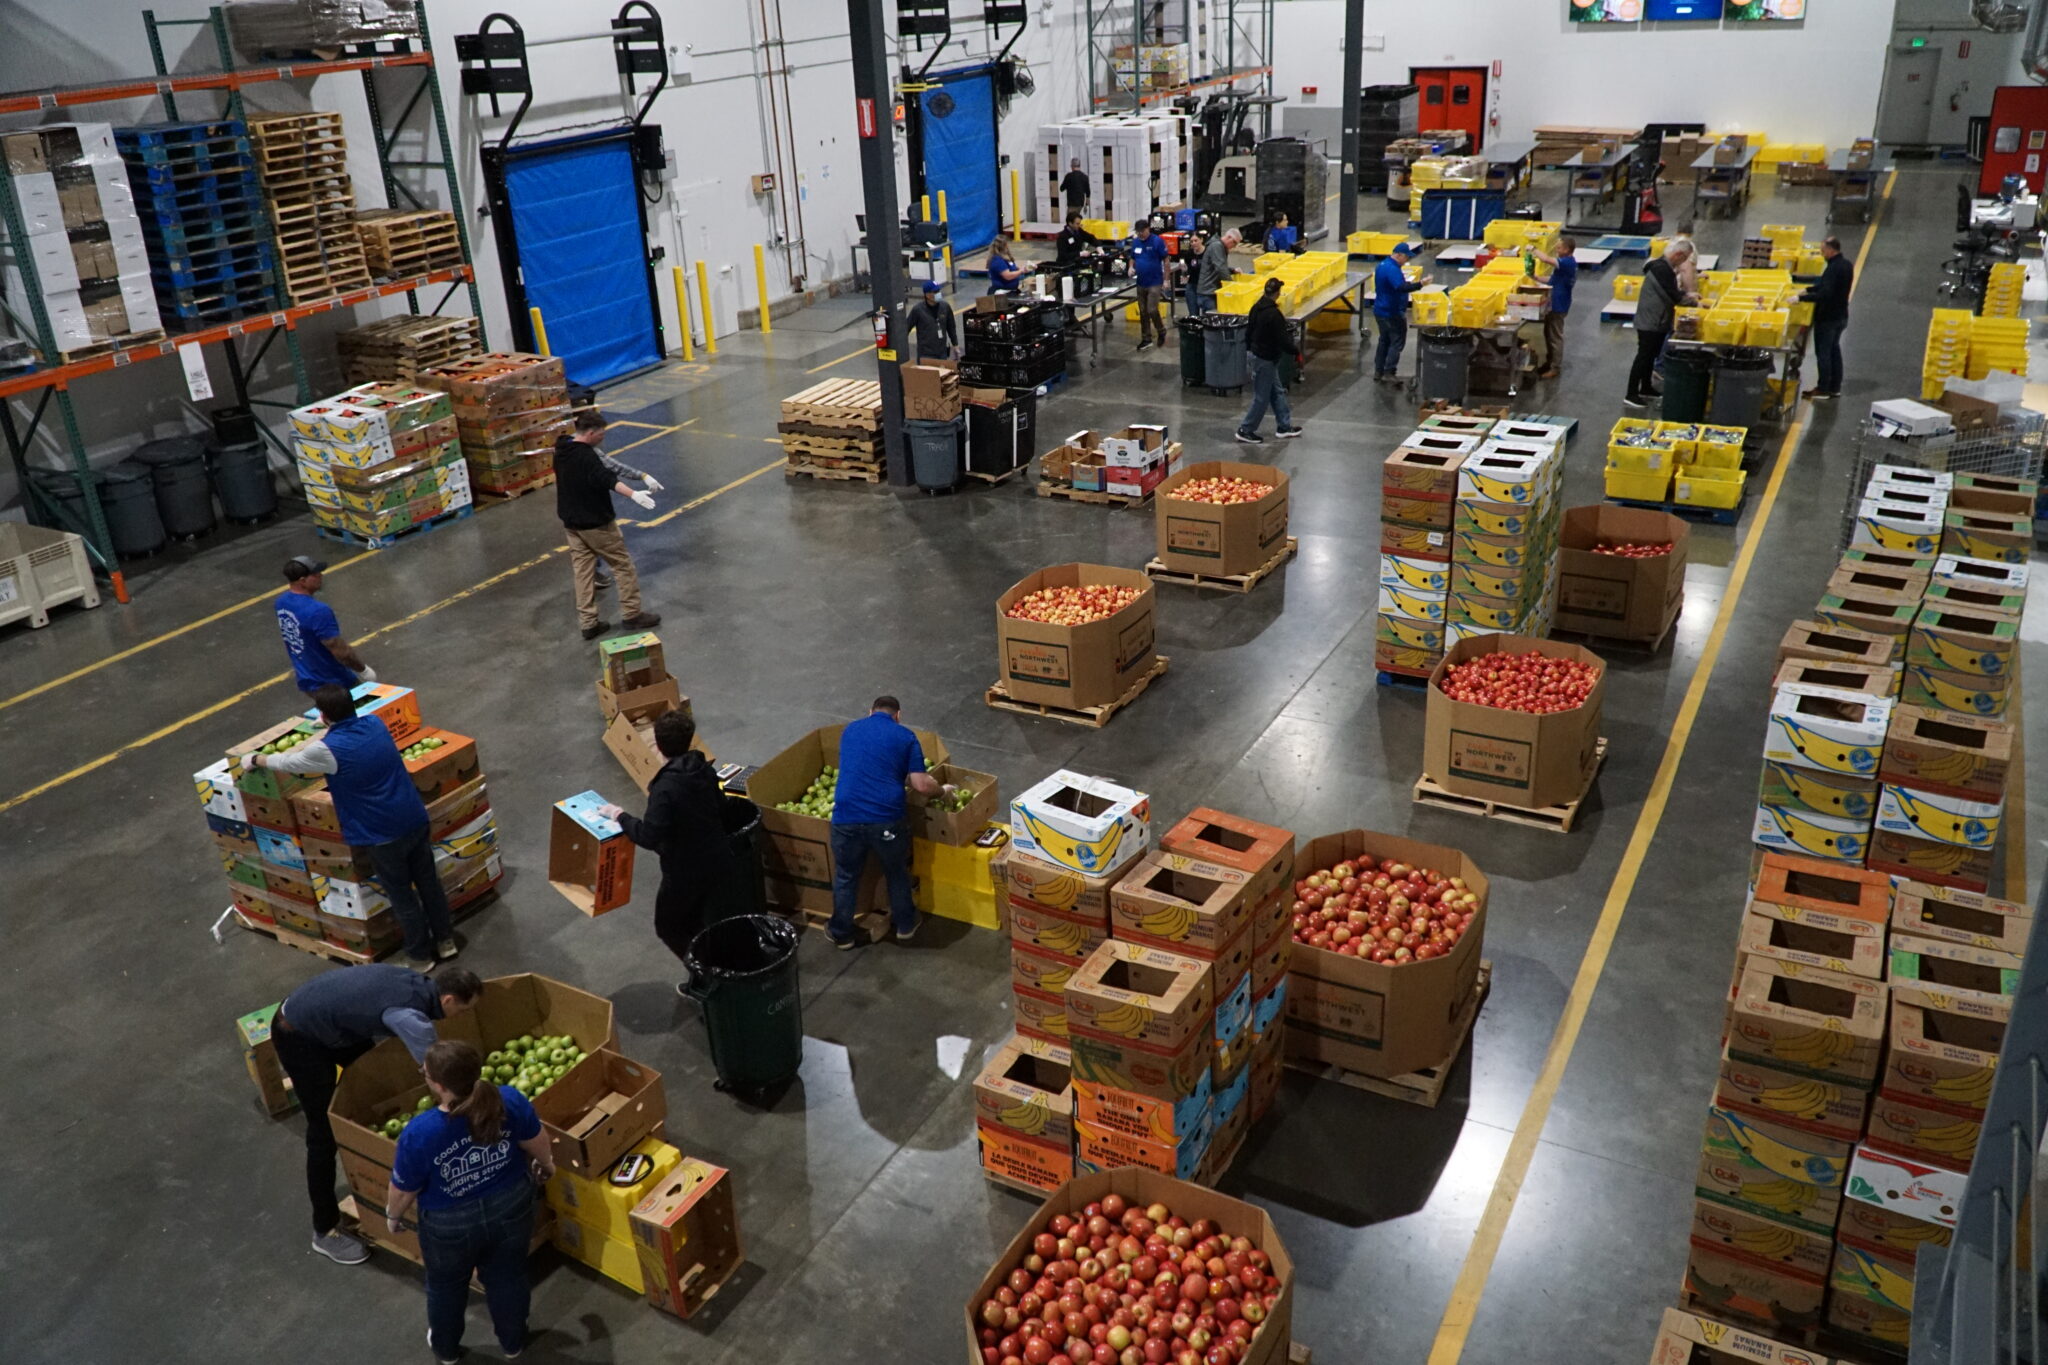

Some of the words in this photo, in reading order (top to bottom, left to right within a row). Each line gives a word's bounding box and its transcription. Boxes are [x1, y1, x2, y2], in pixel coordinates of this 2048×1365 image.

[1019, 654, 1058, 664] NORTHWEST
[1466, 748, 1517, 762] NORTHWEST
[1121, 903, 1141, 916] Dole
[1744, 1024, 1771, 1040] Dole
[1905, 1063, 1933, 1078] Dole
[1734, 1072, 1761, 1088] Dole
[1096, 1111, 1131, 1127] BANANA
[433, 1141, 460, 1166] Good
[481, 1159, 512, 1176] stron
[1026, 1164, 1059, 1179] BANANE
[1126, 1156, 1161, 1171] BANANE
[1714, 1166, 1740, 1184] Dole
[1707, 1214, 1733, 1231] Dole
[1732, 1342, 1772, 1360] PREMIUM
